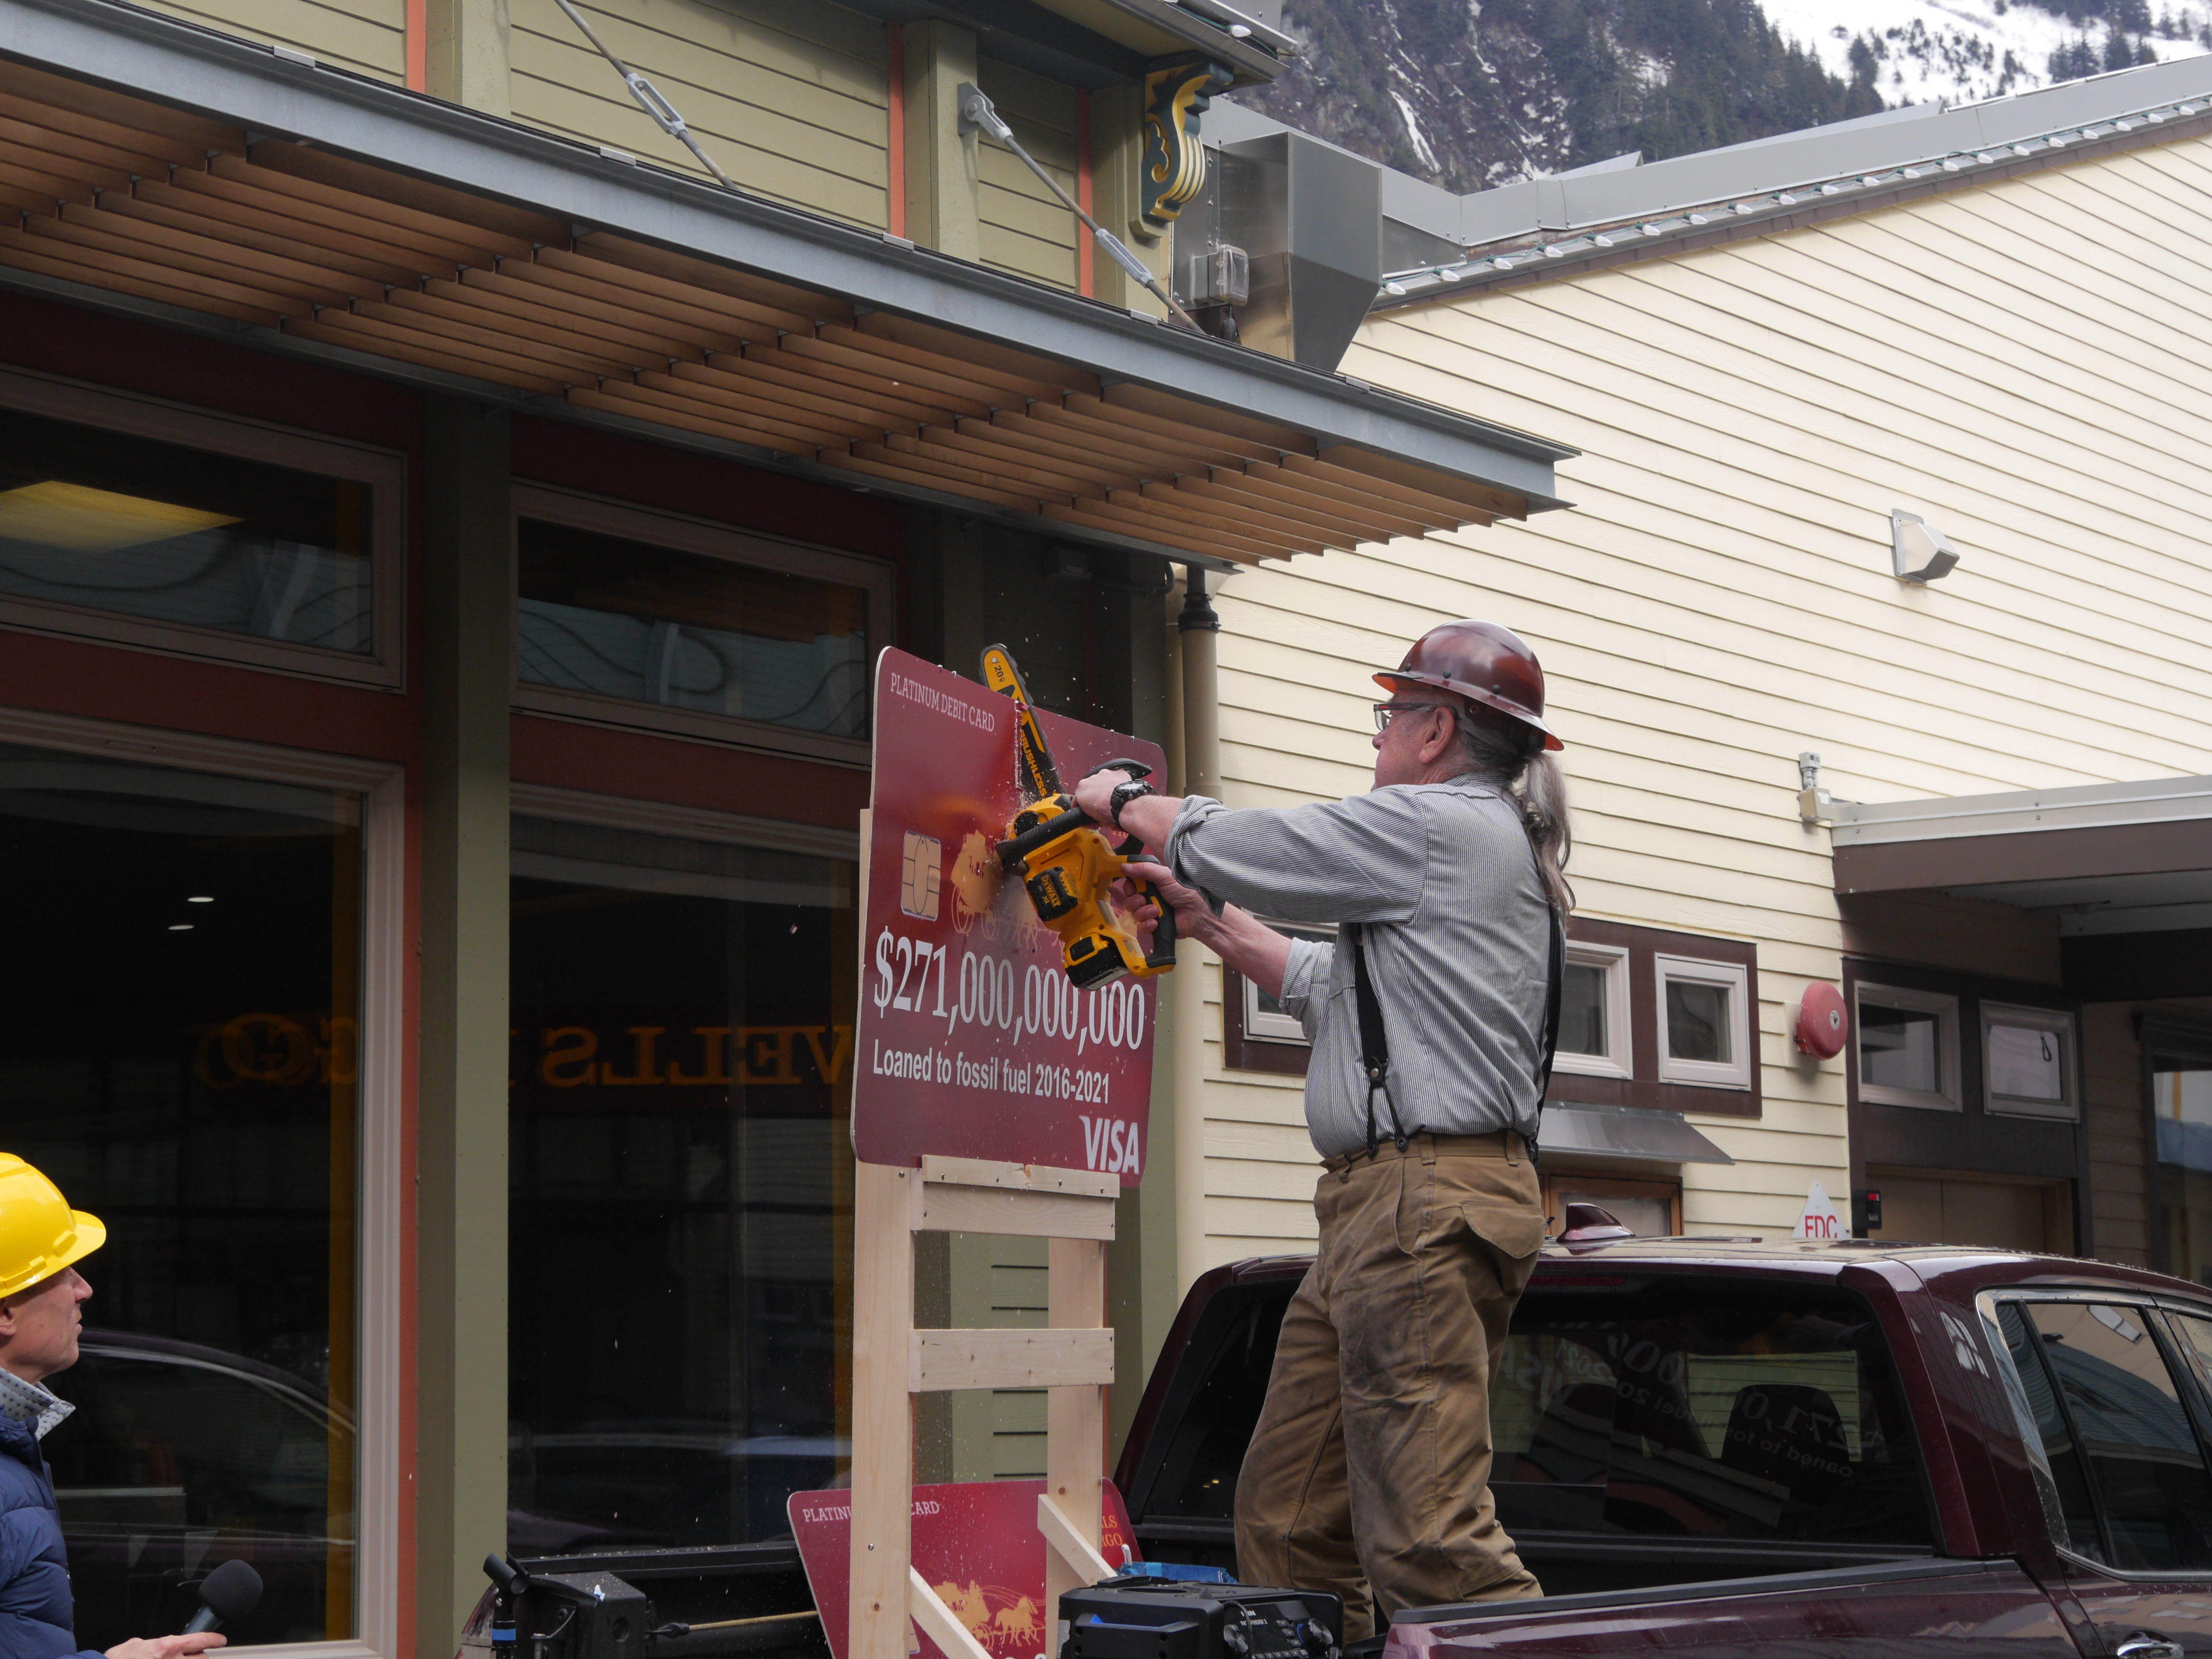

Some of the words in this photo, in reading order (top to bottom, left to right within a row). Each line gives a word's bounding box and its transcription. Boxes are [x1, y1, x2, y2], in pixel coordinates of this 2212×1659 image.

[890, 673, 939, 711] PLATINUM
[941, 693, 967, 721] DEBIT
[969, 706, 994, 732] CARD
[1041, 875, 1061, 907] DEWALT
[873, 925, 1145, 1056] $271,000,000,000
[873, 1039, 932, 1081] Loaned
[937, 1050, 951, 1084] to
[957, 1052, 998, 1090] fossil
[1003, 1059, 1031, 1094] fuel
[1035, 1064, 1109, 1104] 2016-2021
[1079, 1115, 1139, 1174] VISA
[1805, 1215, 1837, 1238] FDC
[802, 1506, 851, 1522] PLATIN
